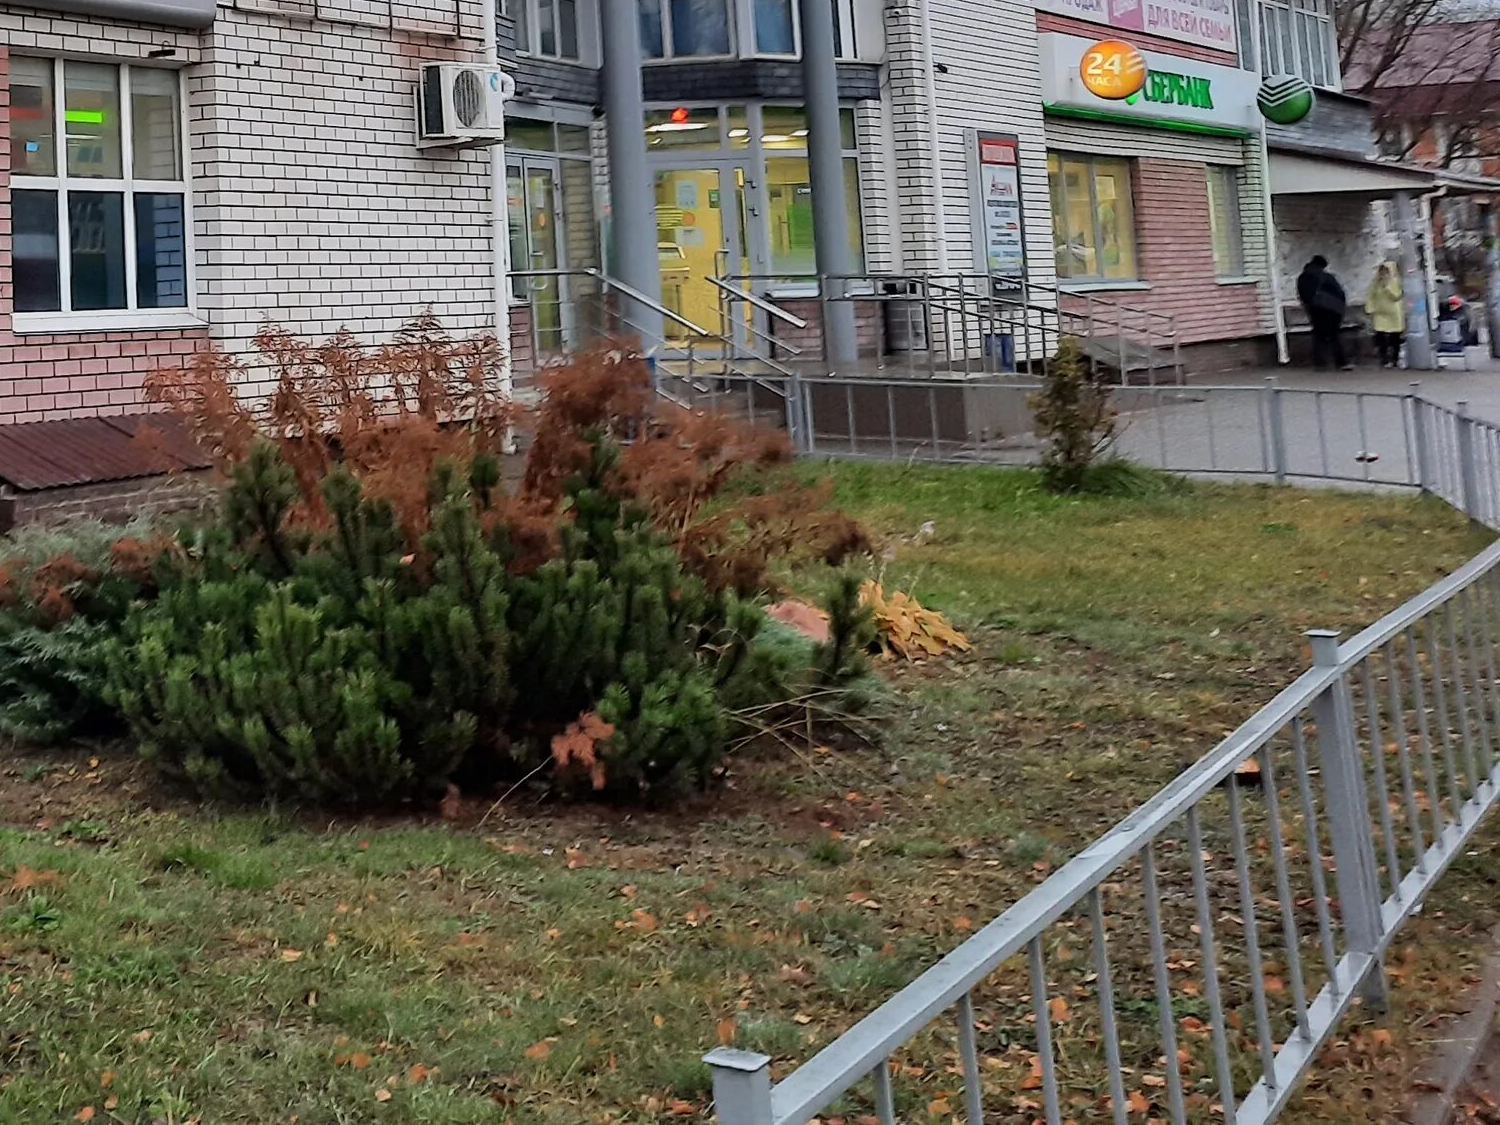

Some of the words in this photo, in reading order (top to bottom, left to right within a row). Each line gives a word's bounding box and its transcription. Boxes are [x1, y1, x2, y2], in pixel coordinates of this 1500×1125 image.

[1147, 4, 1170, 28] ДЛЯ
[1171, 7, 1198, 35] ВСЕЙ
[1086, 52, 1123, 76] 24
